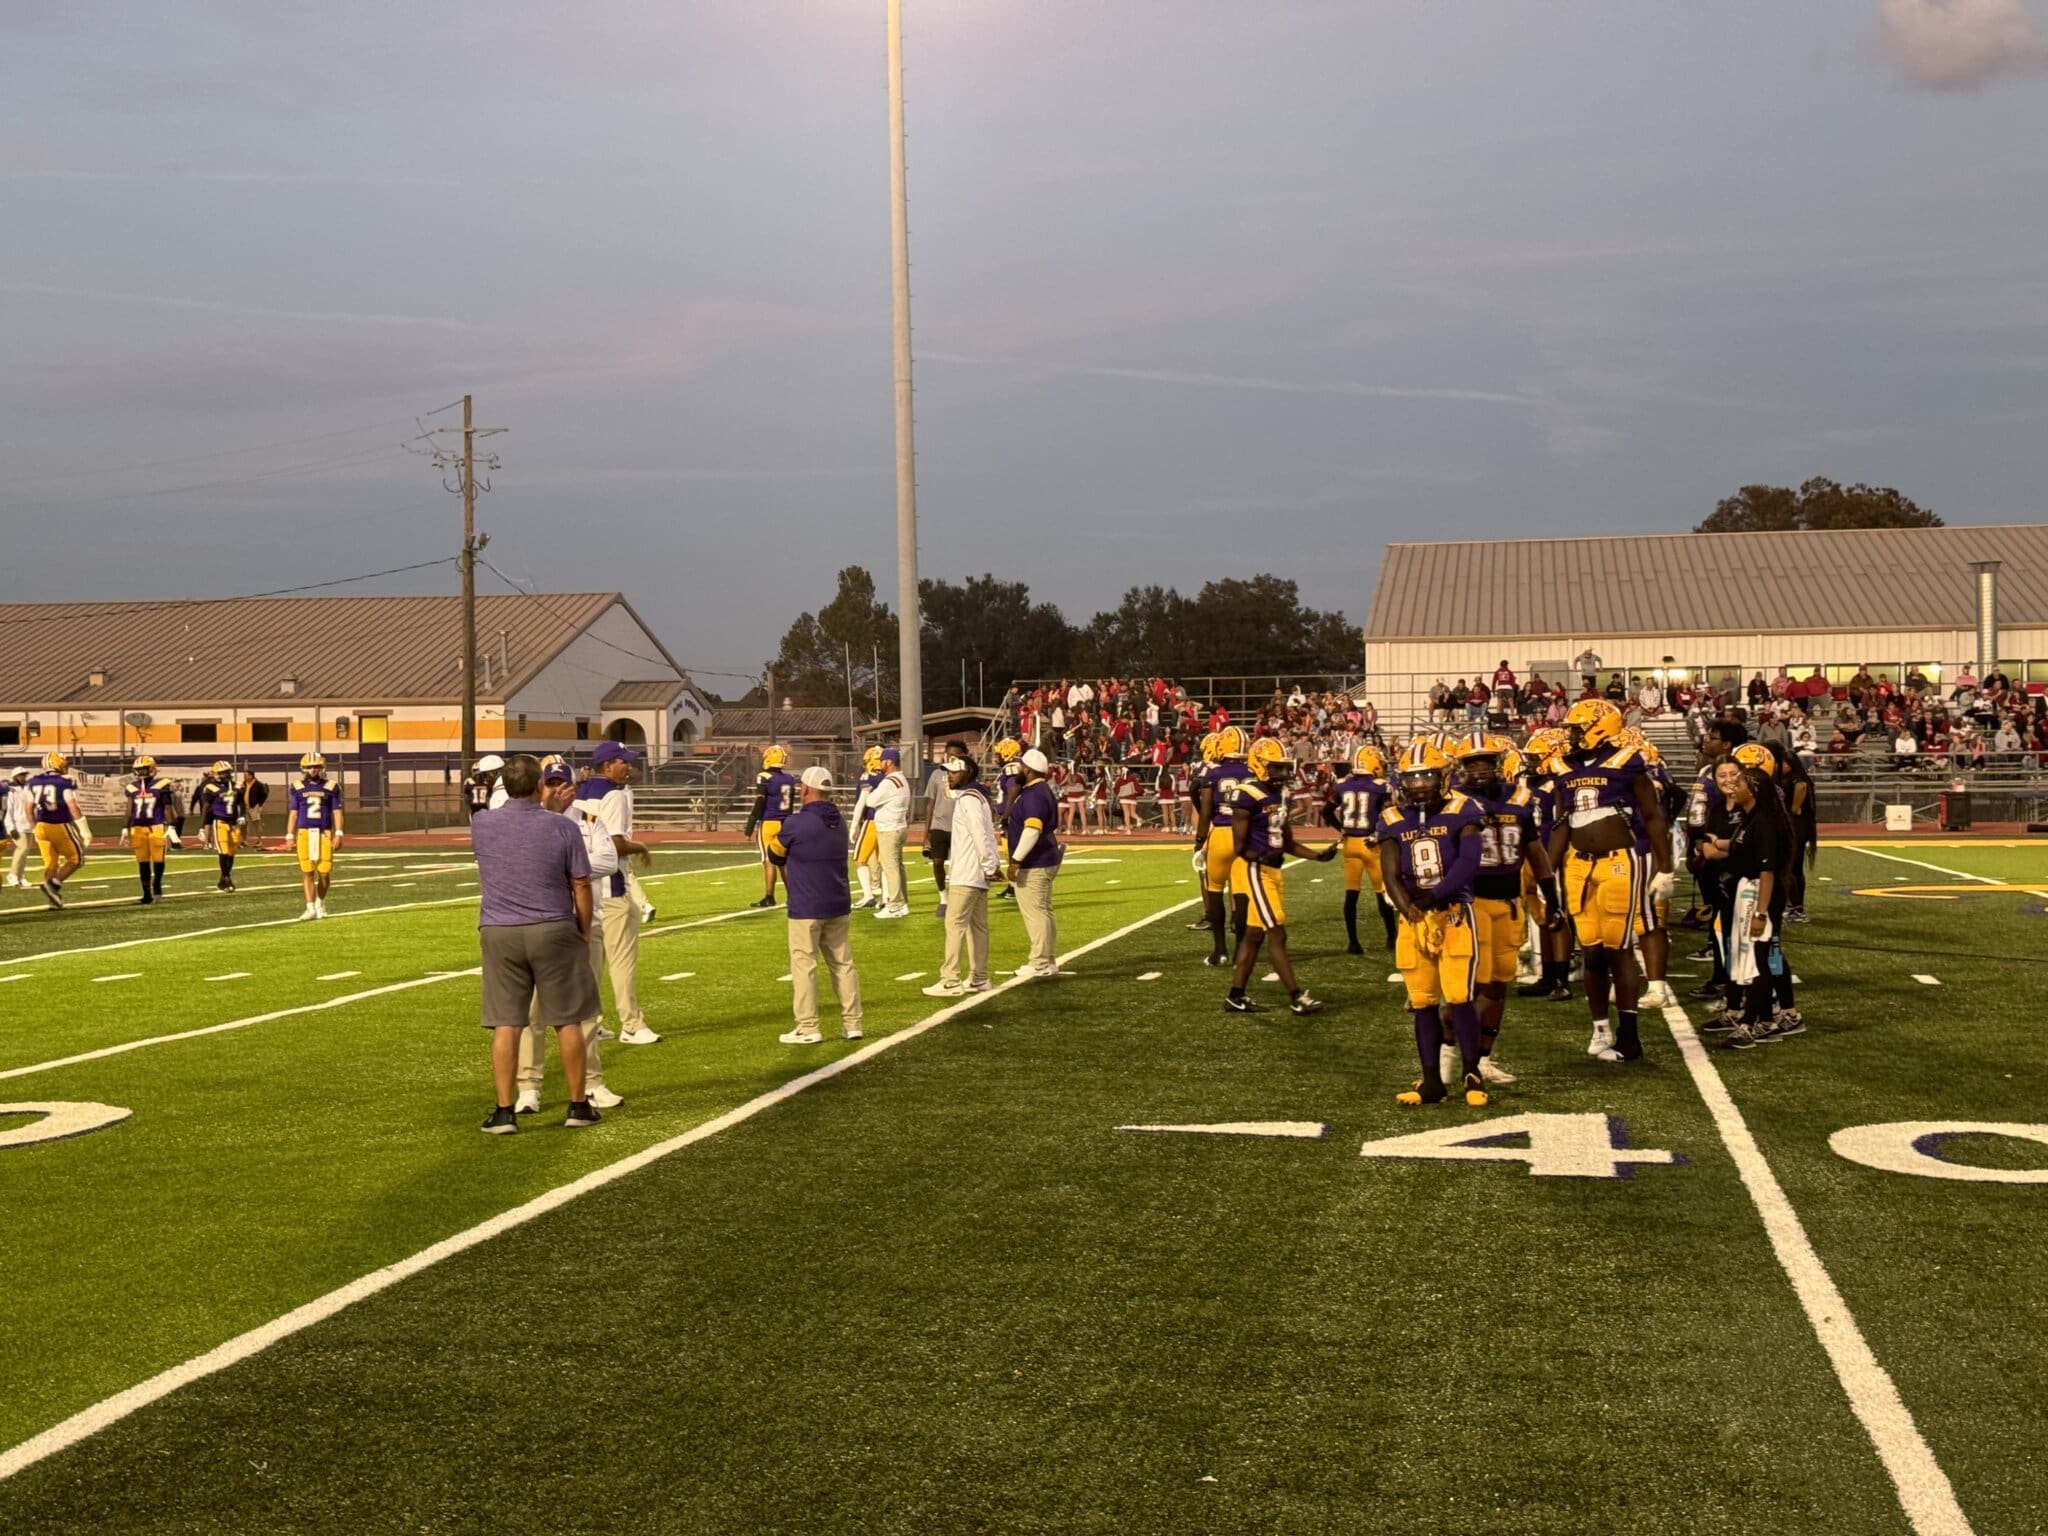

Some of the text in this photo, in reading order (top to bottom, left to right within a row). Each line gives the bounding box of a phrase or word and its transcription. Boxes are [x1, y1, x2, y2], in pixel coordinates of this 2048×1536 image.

[134, 796, 157, 818] 77
[306, 796, 322, 819] 2
[1342, 790, 1370, 829] 21
[1410, 837, 1444, 890] 8
[1360, 1112, 1673, 1177] 4
